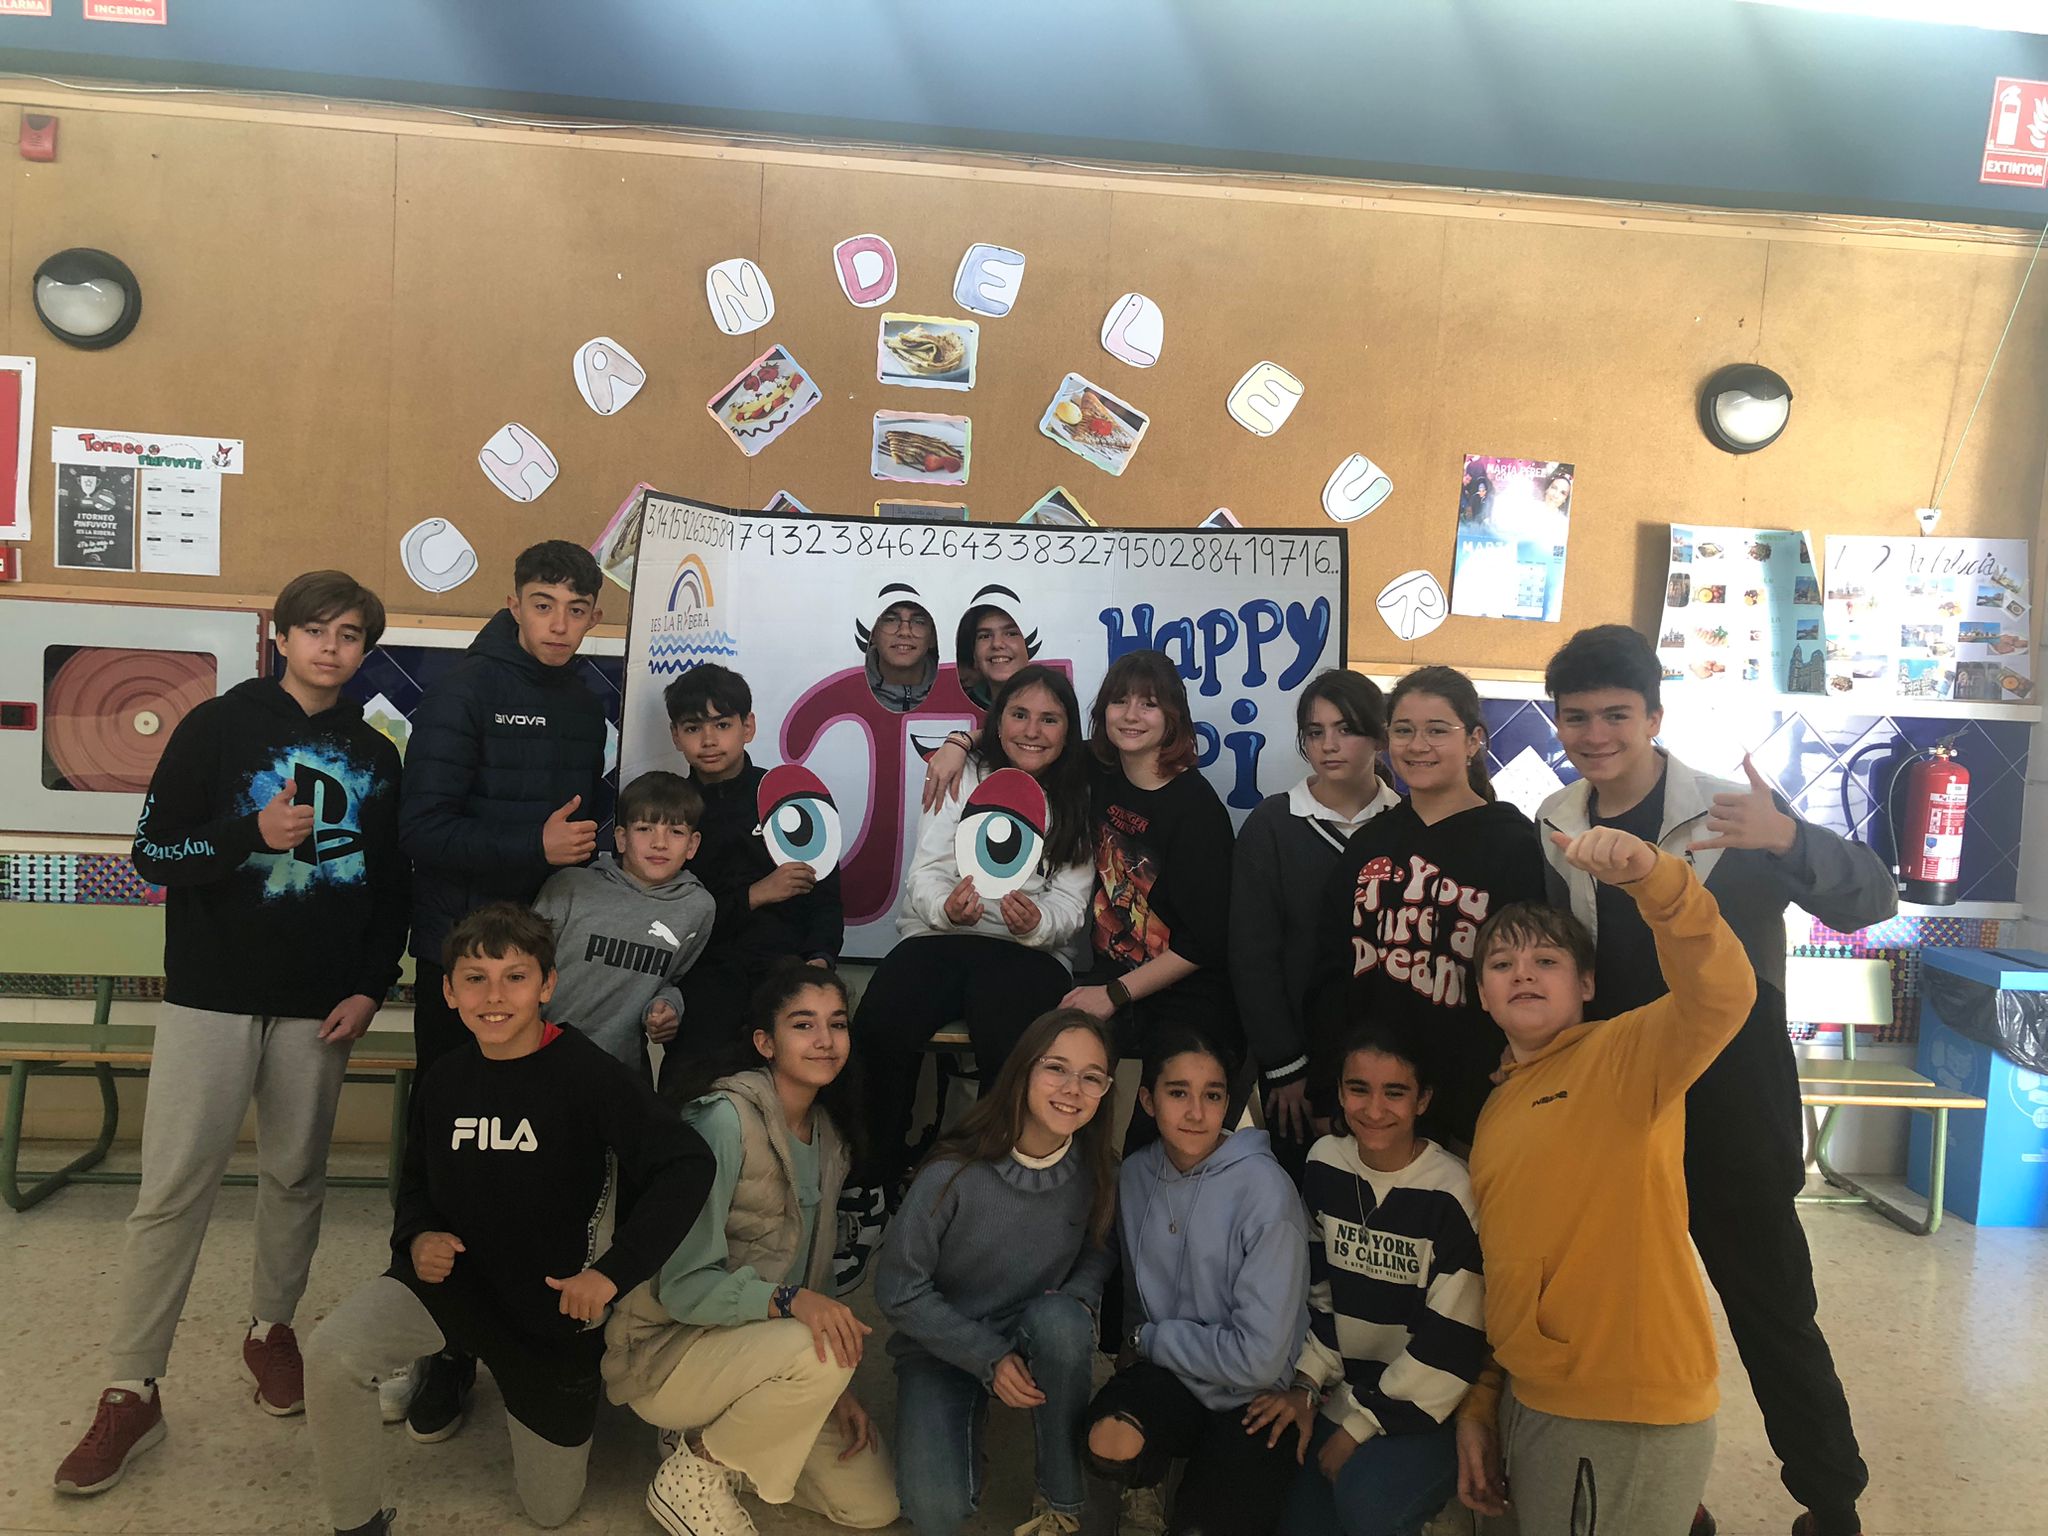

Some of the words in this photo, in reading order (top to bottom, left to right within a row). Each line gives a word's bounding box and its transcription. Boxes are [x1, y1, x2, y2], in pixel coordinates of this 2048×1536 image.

[0, 0, 45, 10] LARMA
[94, 4, 156, 17] INCENDIO
[1985, 159, 2043, 177] EXTINTOR
[78, 433, 144, 455] Torneo
[82, 512, 115, 522] TORNEO
[650, 618, 662, 632] IES
[663, 615, 675, 632] LA
[1450, 918, 1477, 961] a
[584, 934, 674, 978] PUMA
[451, 1116, 539, 1152] FILA
[1336, 1223, 1370, 1246] NEW
[1372, 1234, 1417, 1258] YORK
[1334, 1239, 1350, 1256] IS
[1355, 1247, 1420, 1273] CALLING
